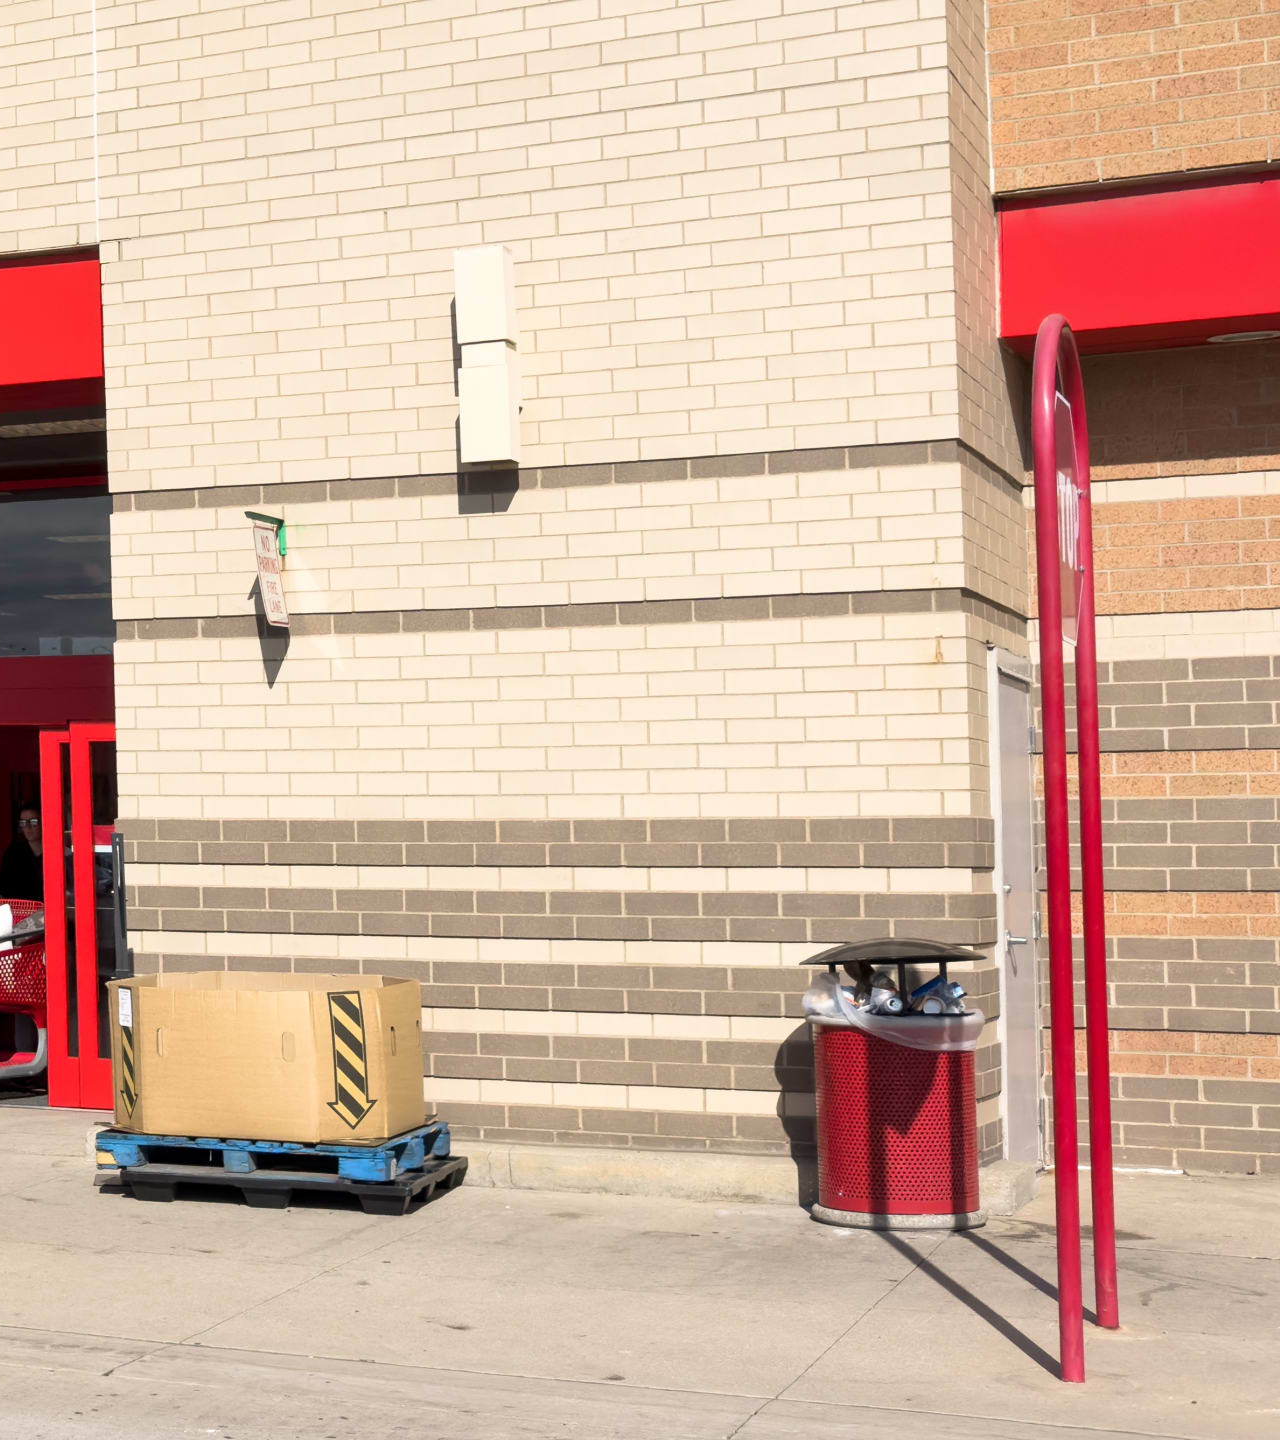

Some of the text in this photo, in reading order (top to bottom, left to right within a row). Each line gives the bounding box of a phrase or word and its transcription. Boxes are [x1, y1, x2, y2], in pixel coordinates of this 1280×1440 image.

[261, 535, 270, 553] NO
[259, 555, 279, 574] PARKING
[266, 580, 278, 596] FIRE
[271, 600, 283, 614] LANE
